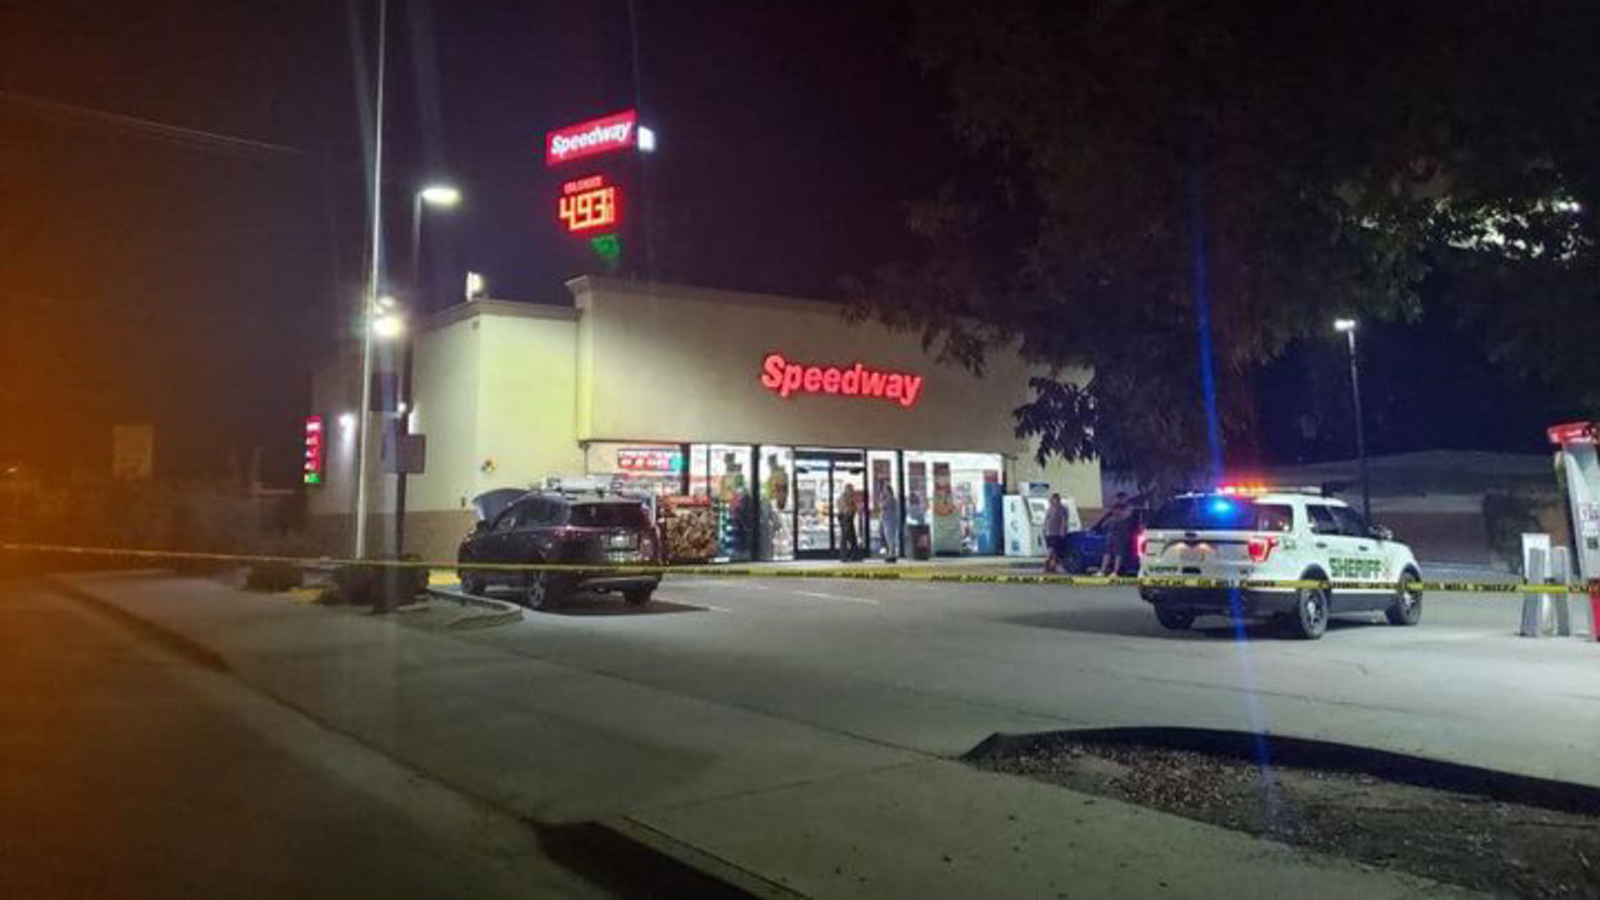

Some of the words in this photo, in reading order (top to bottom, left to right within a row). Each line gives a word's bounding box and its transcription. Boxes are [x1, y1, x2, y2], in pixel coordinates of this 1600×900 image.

[550, 121, 632, 159] Speedway
[762, 355, 921, 405] Speedway
[1329, 557, 1381, 579] SHERIFF
